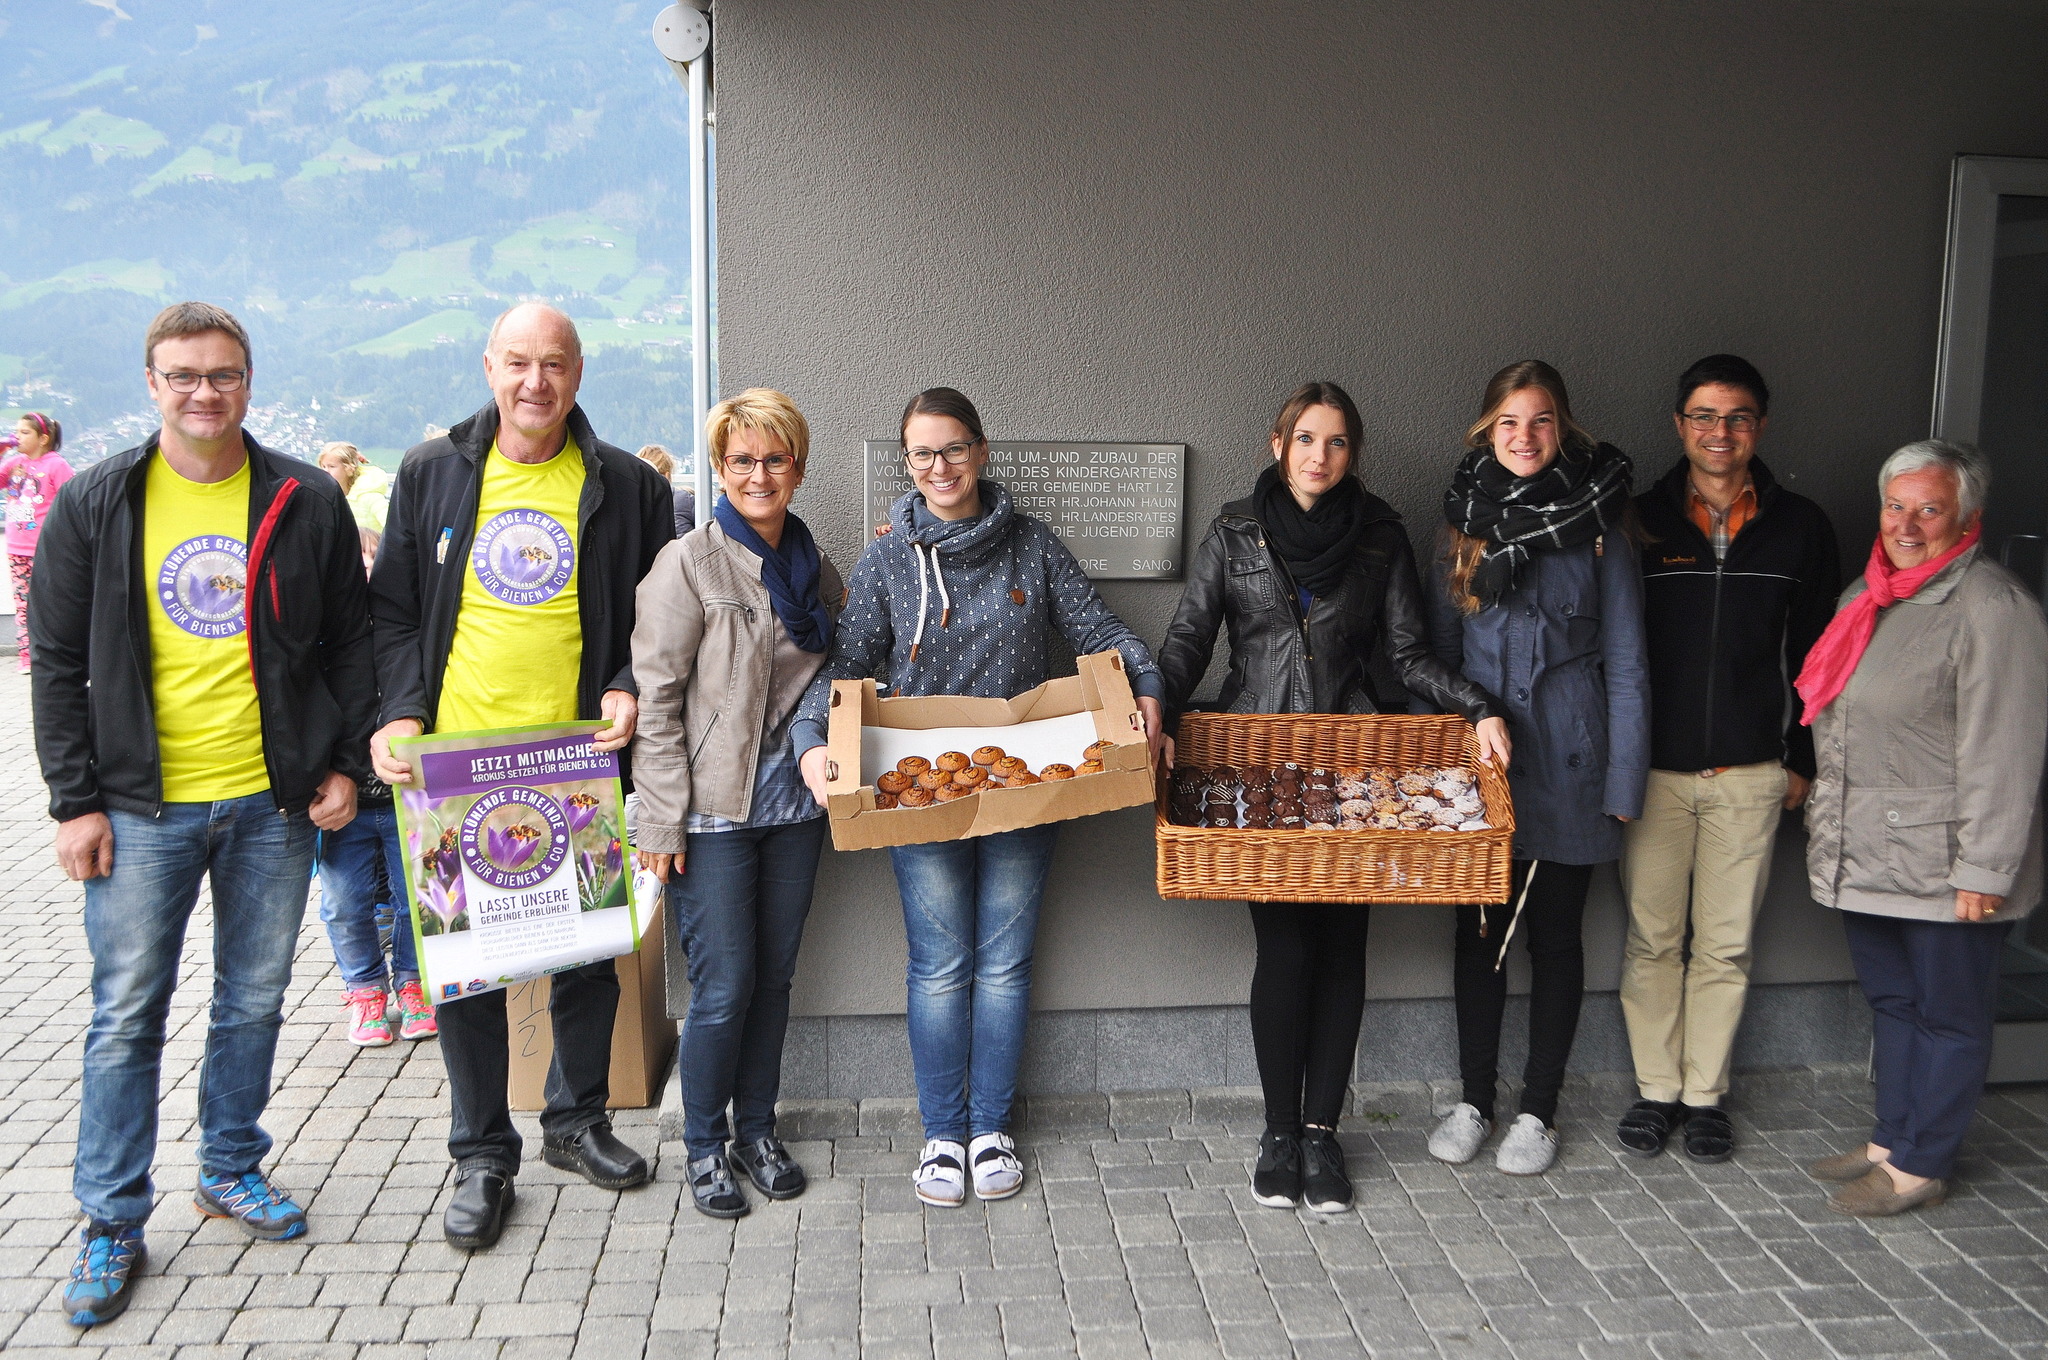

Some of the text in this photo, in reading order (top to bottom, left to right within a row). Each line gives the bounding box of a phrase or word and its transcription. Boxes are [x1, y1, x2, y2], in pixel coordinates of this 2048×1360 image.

[873, 450, 889, 462] IM
[987, 450, 1013, 463] 004
[1089, 451, 1138, 464] ZUBAU
[1147, 452, 1178, 464] DER
[986, 466, 1017, 478] UND
[1020, 466, 1050, 478] DES
[1056, 466, 1178, 479] KINDERGARTENS
[1011, 481, 1039, 493] DER
[1043, 481, 1111, 493] GEMEINDE
[1117, 482, 1152, 493] HART
[873, 495, 896, 507] MIT
[1141, 497, 1177, 508] HAUN
[526, 511, 572, 554] GEMEINDE
[1052, 525, 1176, 538] DIE JUGEND DER
[480, 570, 568, 603] FÜR BIENEN & CO
[167, 602, 189, 625] FÜR
[190, 620, 237, 636] BIENEN
[470, 755, 512, 773] JETZT
[472, 758, 611, 783] KROKUS SETZEN FÜR BIENEN & CO
[463, 789, 565, 842] BLÜHENDE GEMEINDE
[471, 846, 564, 887] FÜR BIENEN & CO
[478, 888, 570, 914] LASST UNSERE
[480, 903, 571, 925] GEMEINDE ERBLÜHEN!
